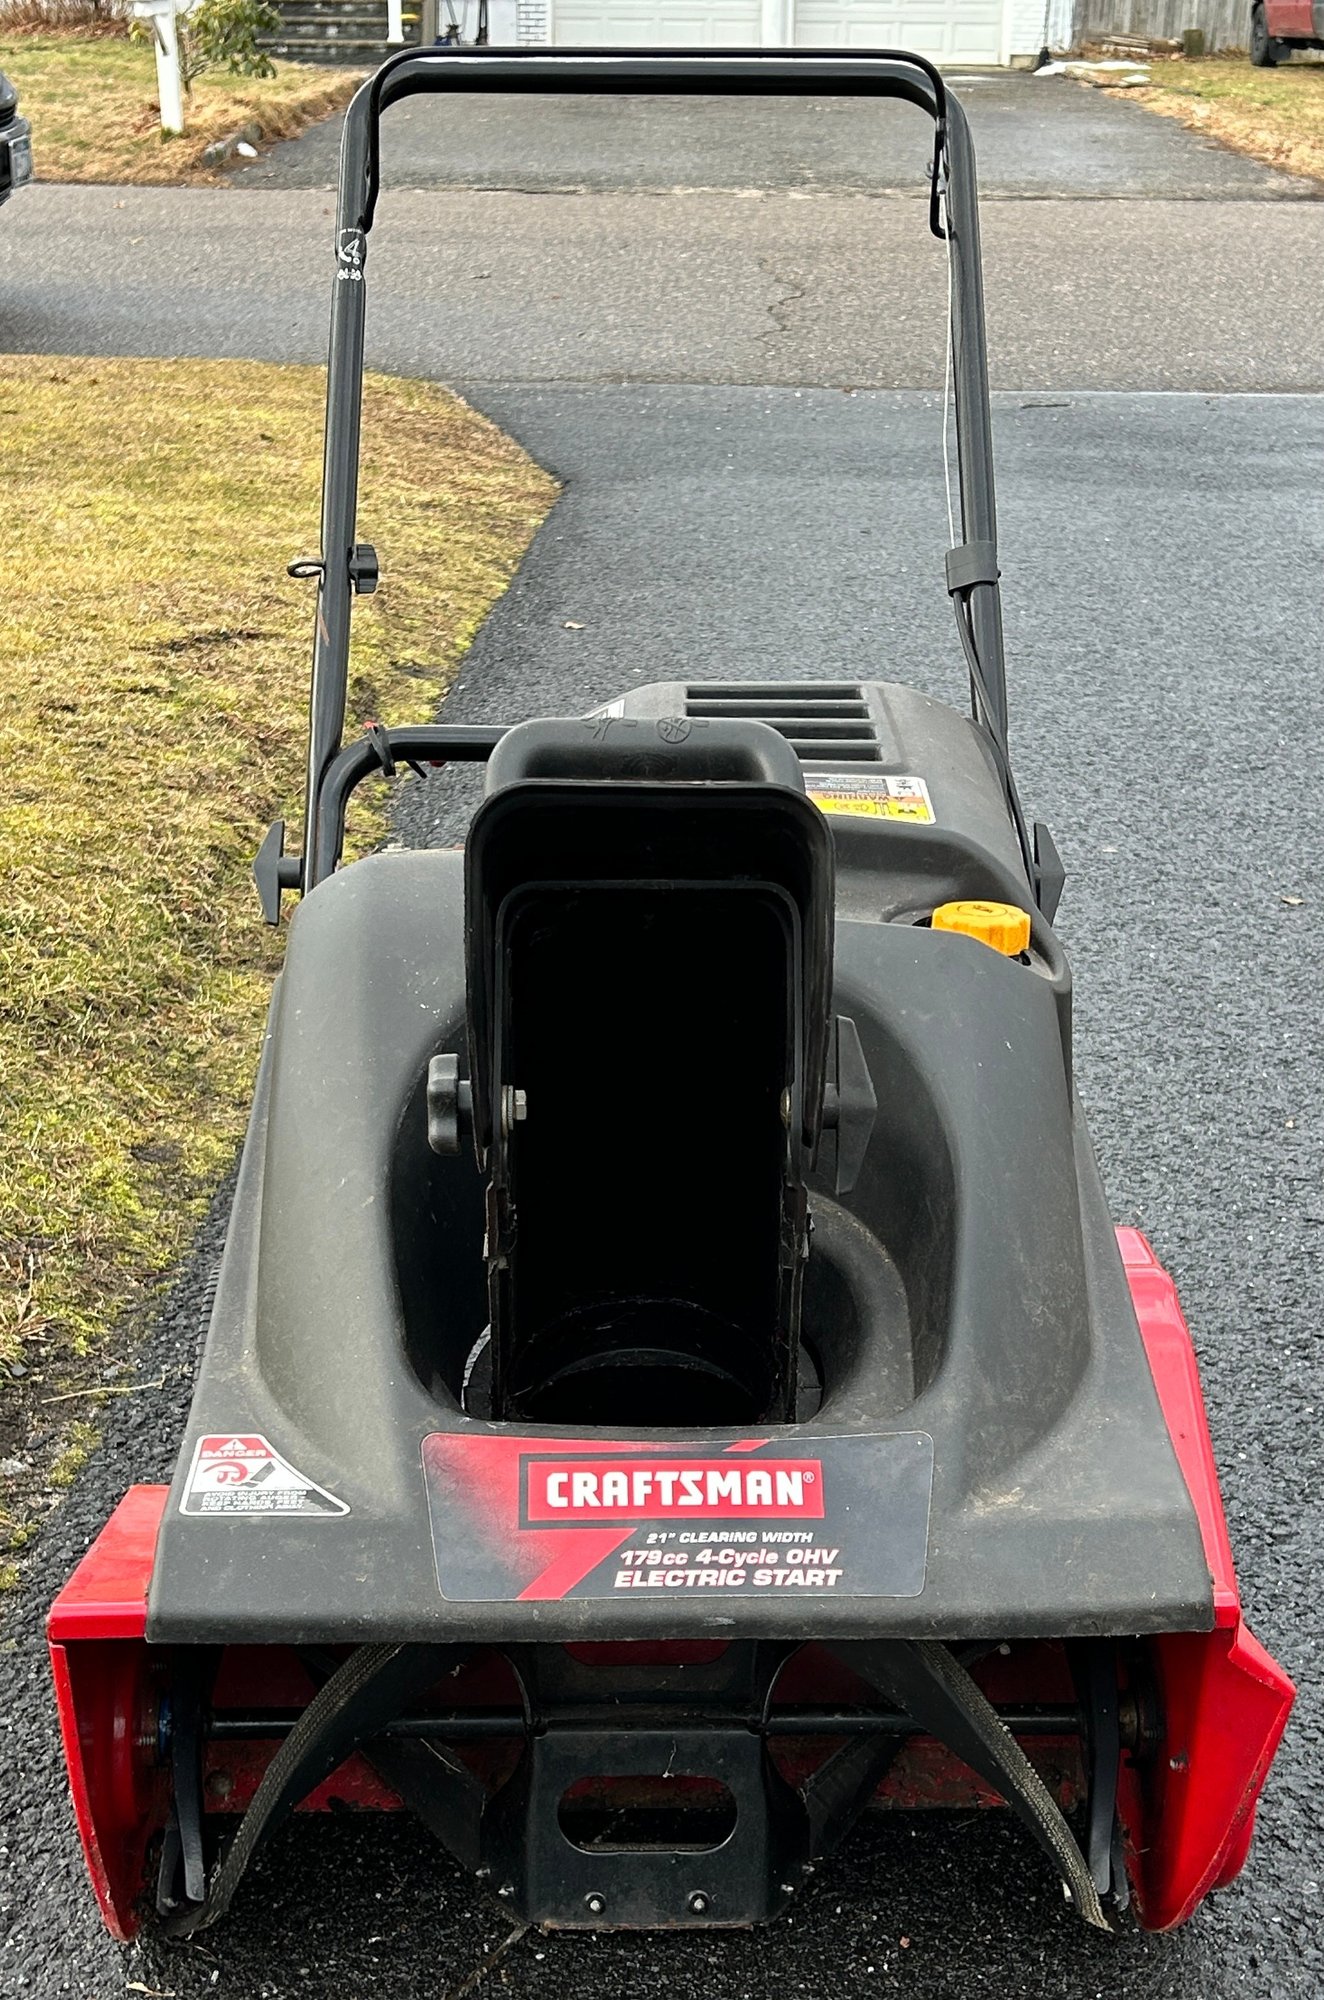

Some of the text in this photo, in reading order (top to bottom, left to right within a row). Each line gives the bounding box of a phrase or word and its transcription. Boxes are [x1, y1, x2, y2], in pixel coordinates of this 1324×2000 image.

[646, 1531, 813, 1544] 21" CLEARING WIDTH
[620, 1548, 839, 1568] 179cc 4-Cycle OHV
[614, 1569, 843, 1588] ELECTRIC START
